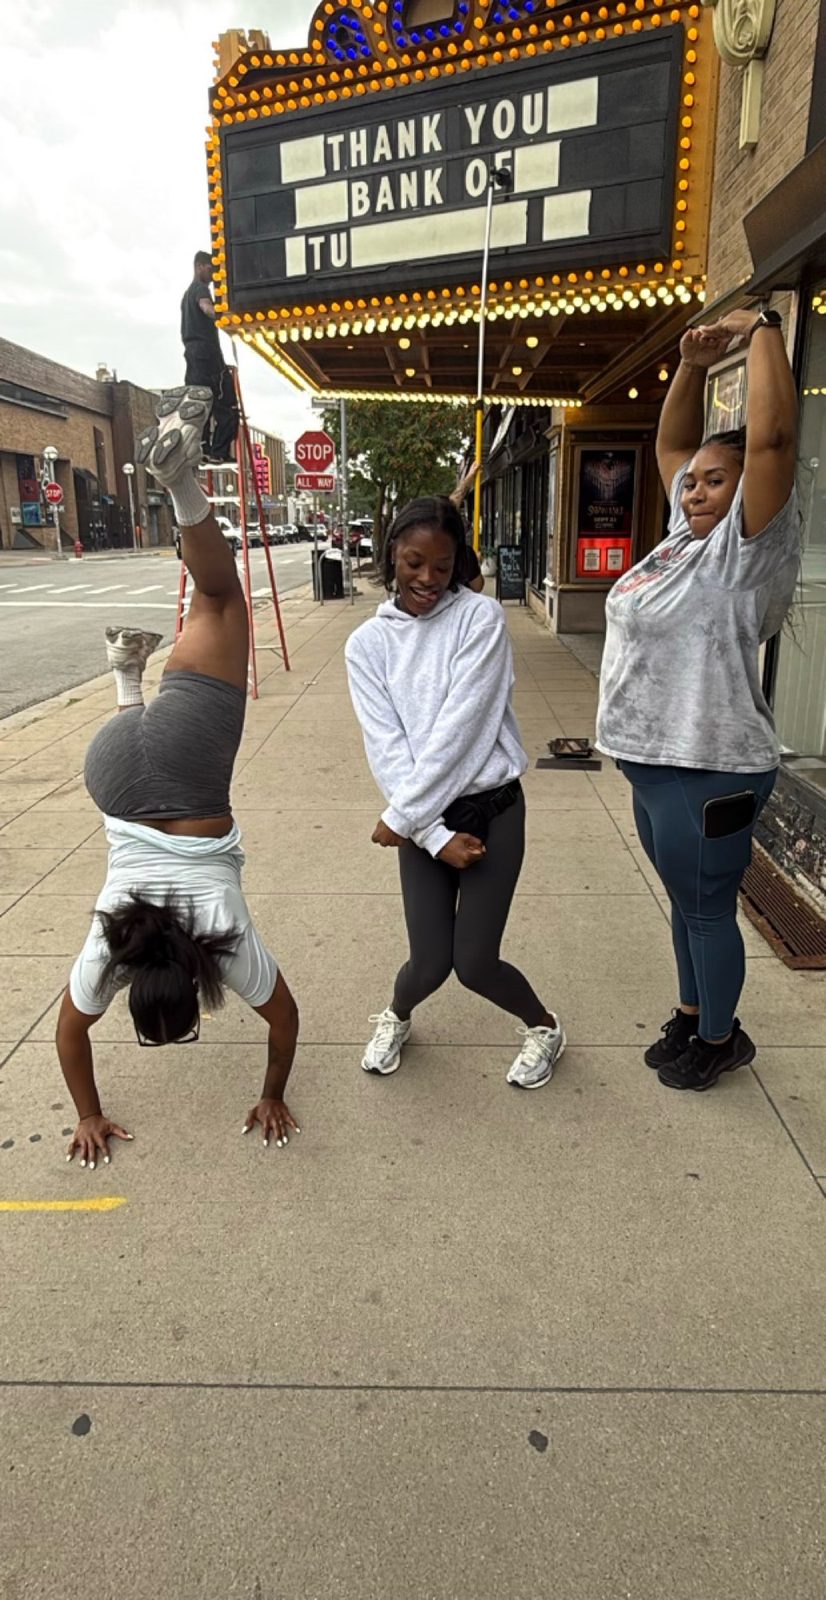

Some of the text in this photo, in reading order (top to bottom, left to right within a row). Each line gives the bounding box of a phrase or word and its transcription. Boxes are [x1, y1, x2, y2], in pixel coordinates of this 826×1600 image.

[327, 92, 544, 171] THANK YOU
[351, 150, 512, 218] BANK OF
[308, 231, 348, 271] TU
[297, 443, 332, 461] STOP
[46, 489, 62, 498] STOP
[297, 477, 333, 488] ALL WAY
